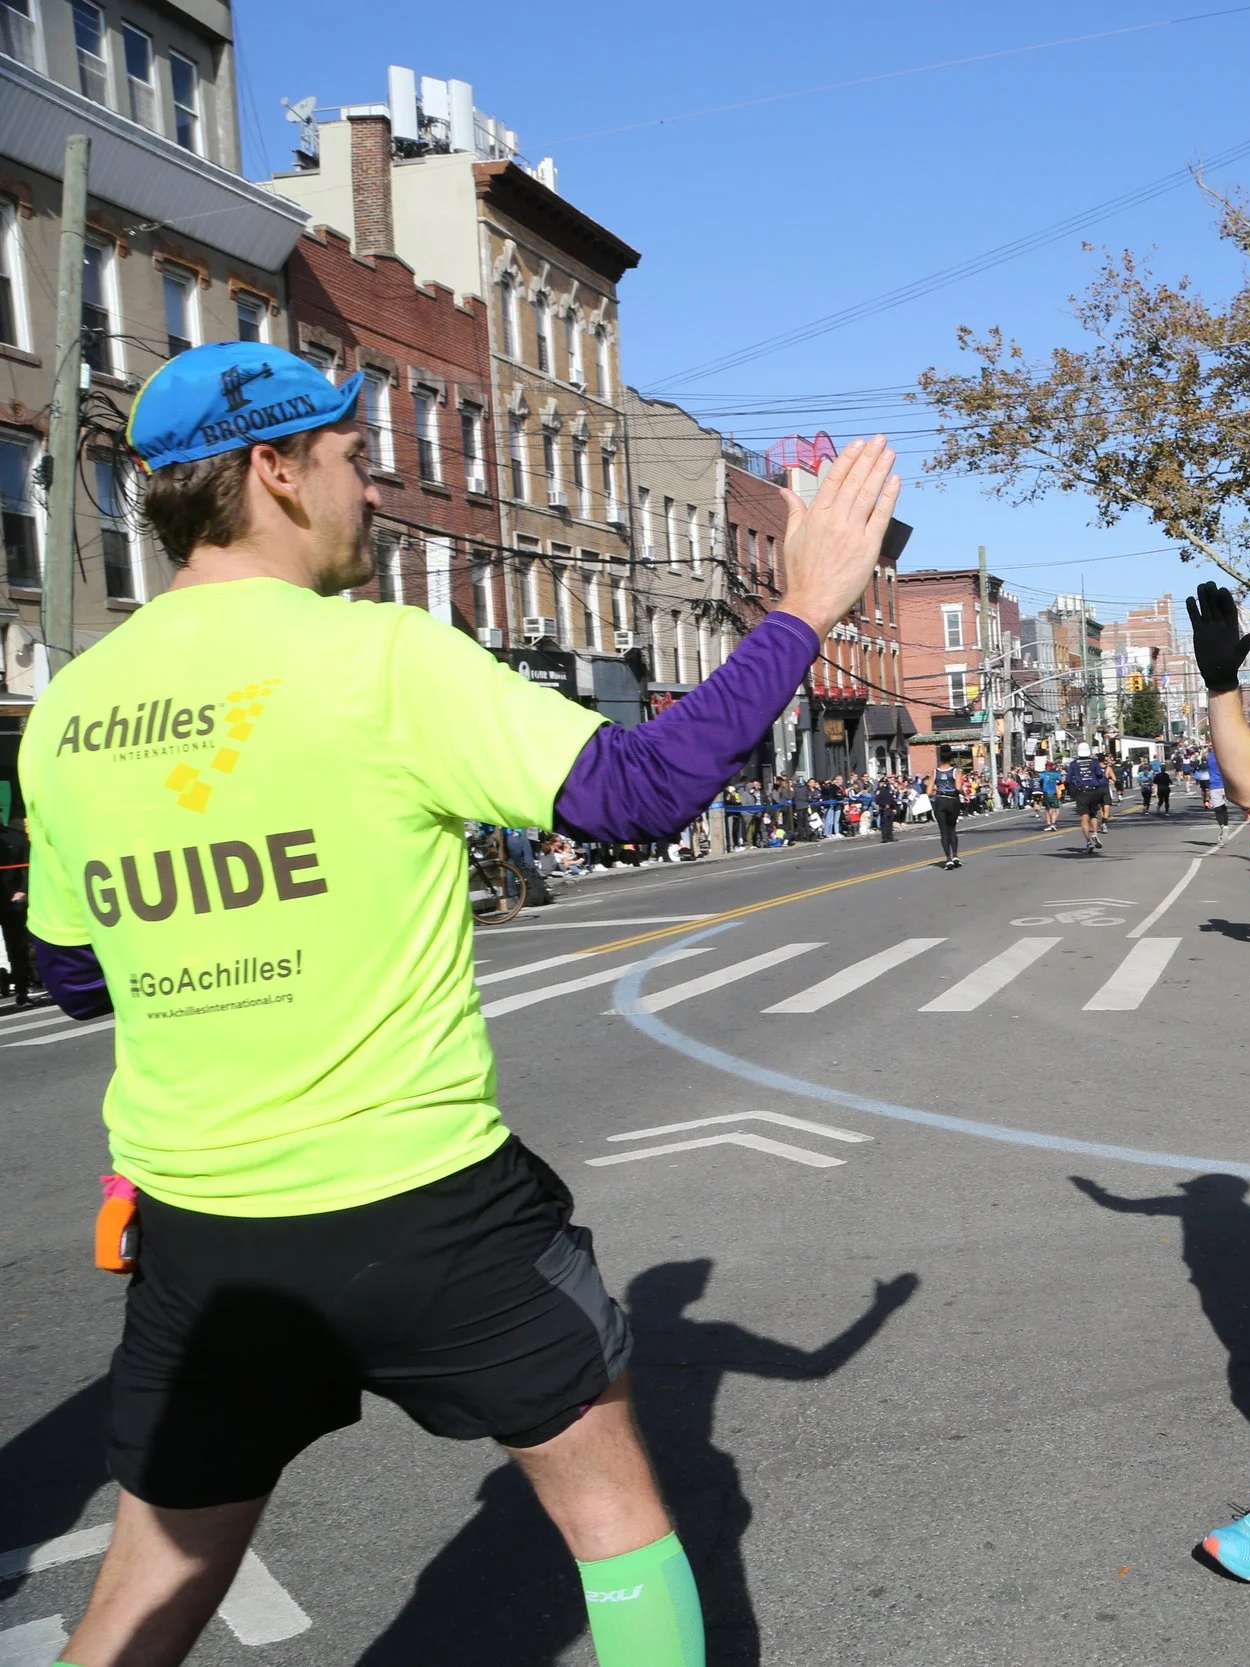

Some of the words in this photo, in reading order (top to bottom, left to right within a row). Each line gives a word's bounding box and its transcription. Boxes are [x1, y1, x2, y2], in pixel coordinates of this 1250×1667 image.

[200, 393, 318, 447] BROOKLYN
[56, 697, 216, 758] Achilles
[113, 740, 216, 763] INTERNATIONAL
[84, 828, 329, 928] GUIDE
[130, 949, 303, 998] #GoAchilles!
